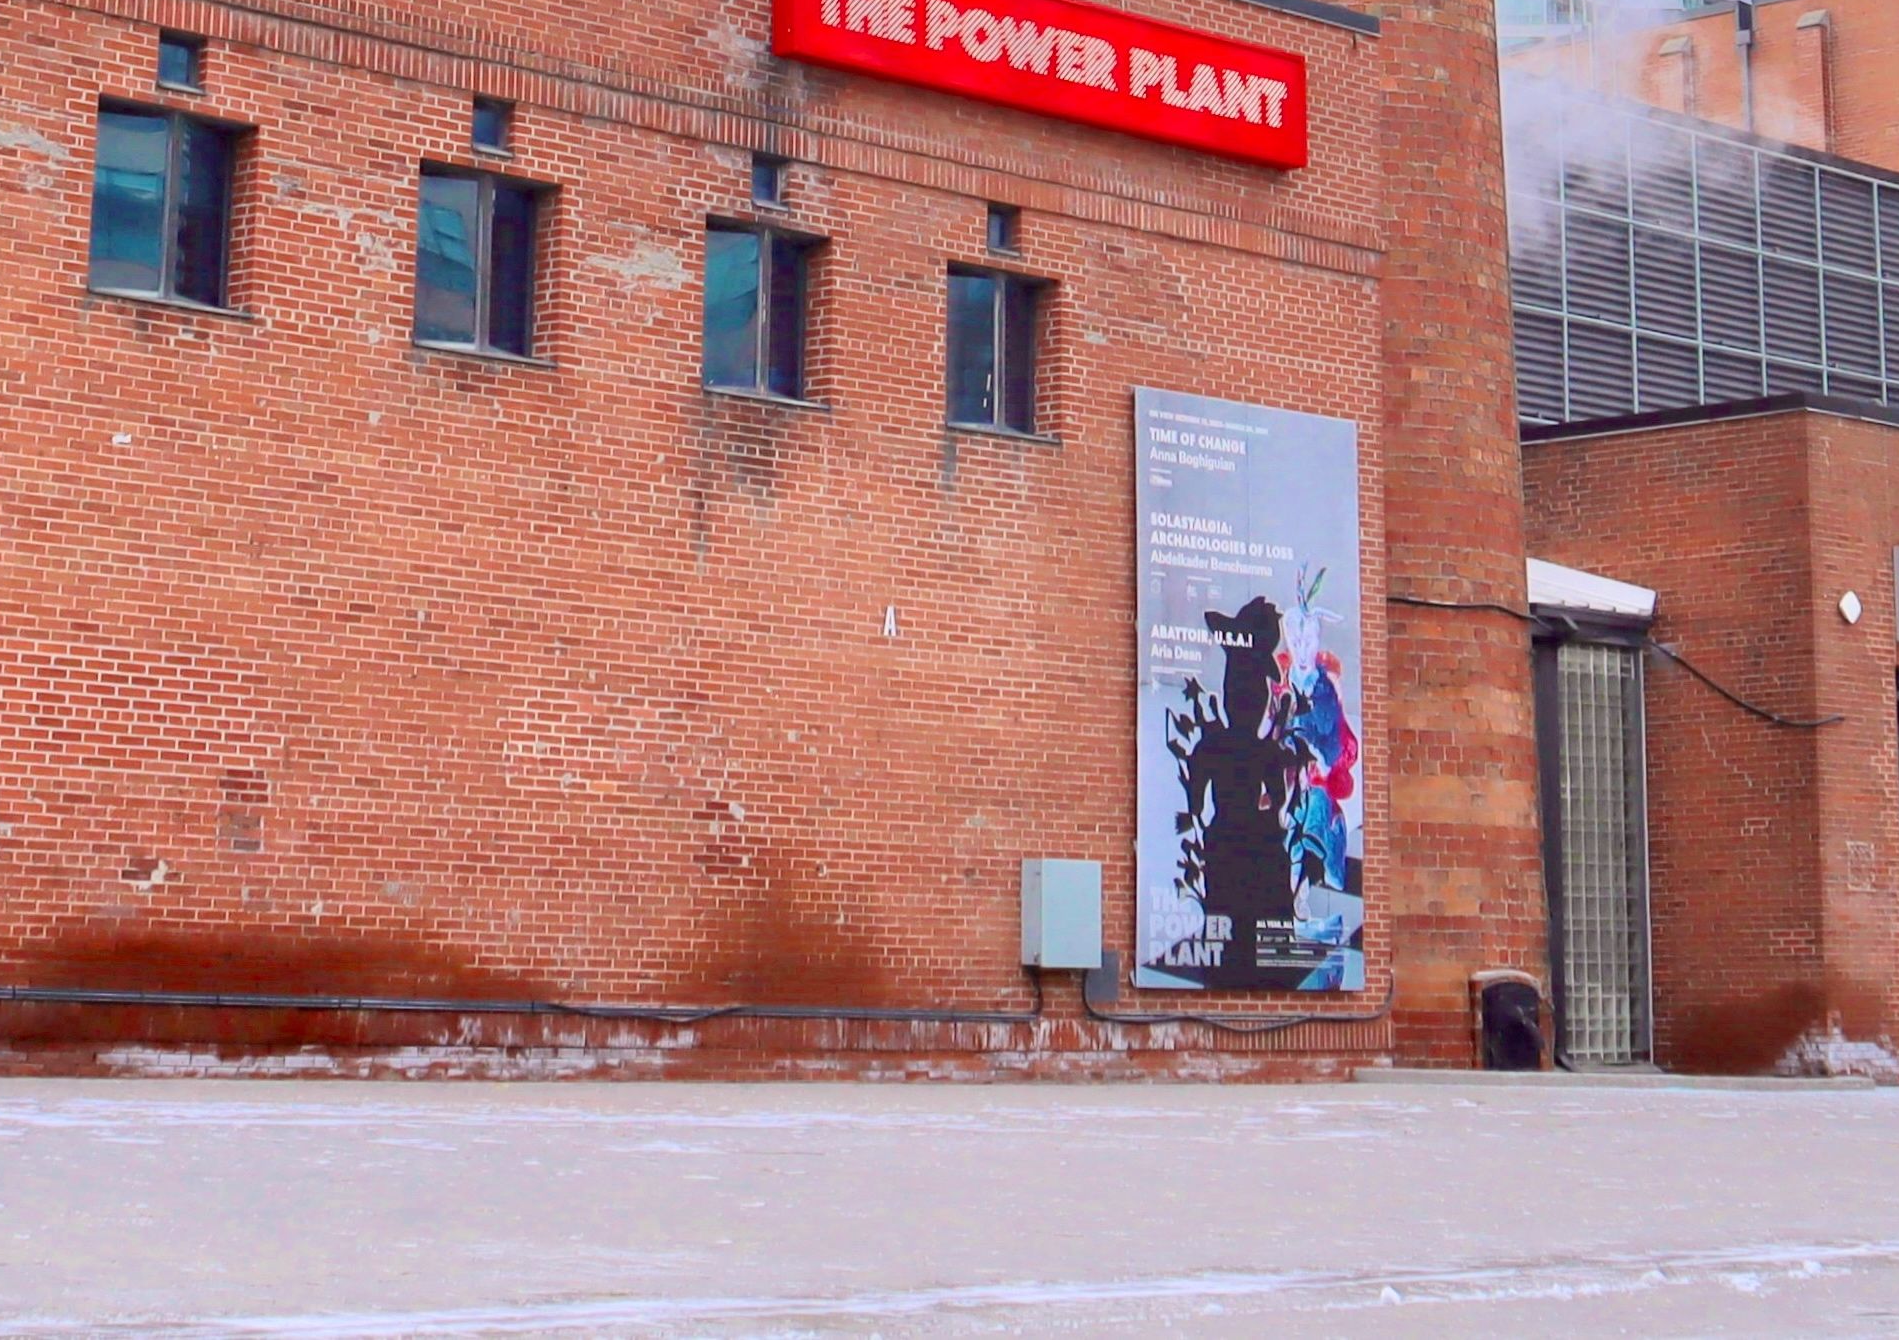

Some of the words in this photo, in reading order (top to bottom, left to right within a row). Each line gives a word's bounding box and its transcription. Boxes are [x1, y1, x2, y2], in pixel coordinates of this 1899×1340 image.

[1129, 46, 1288, 128] PLANT
[1149, 426, 1178, 444] TIME
[1180, 431, 1195, 447] OF
[1198, 434, 1247, 455] CHANGE
[1149, 446, 1177, 463] Anna
[1179, 450, 1236, 472] Boghiguian
[1150, 512, 1233, 535] SOLASTALGIA:
[1150, 530, 1246, 555] ARCHAEOLOGIES
[1248, 543, 1263, 557] OF
[1266, 545, 1295, 561] LOSS
[1150, 550, 1209, 569] Abdelkader
[883, 605, 897, 637] A
[1151, 624, 1213, 646] ABATTOIR,
[1151, 643, 1173, 659] Aria
[1175, 646, 1202, 662] Dean
[1149, 913, 1233, 941] POWER
[1149, 941, 1224, 967] PLANT
